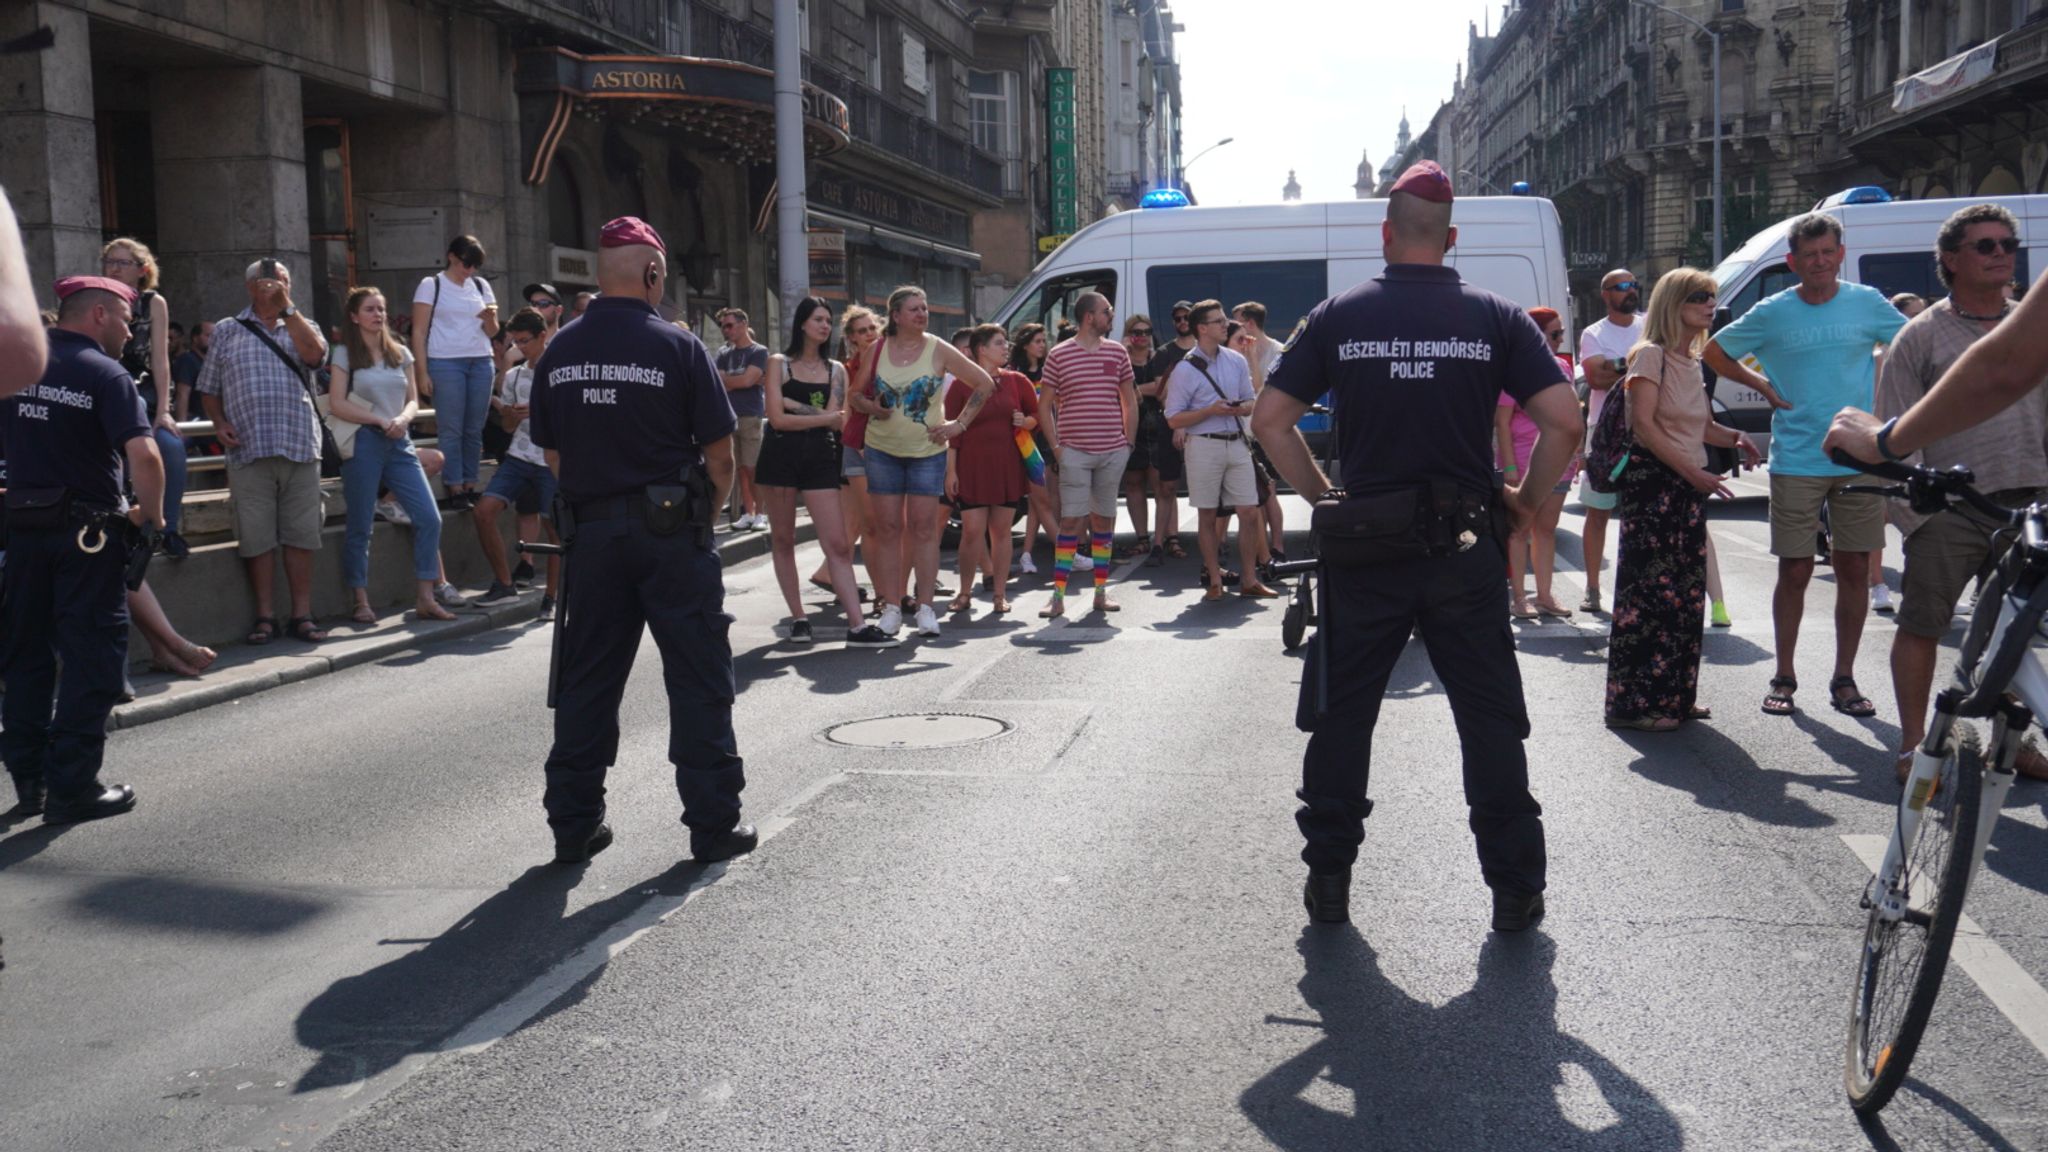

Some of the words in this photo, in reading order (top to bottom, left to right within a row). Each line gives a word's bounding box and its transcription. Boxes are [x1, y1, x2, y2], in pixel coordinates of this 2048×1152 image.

[591, 71, 686, 90] ASTORIA
[1054, 71, 1067, 141] ASTOR
[854, 185, 899, 220] ASTORIA
[559, 257, 589, 276] HOTEL
[1338, 337, 1410, 361] KÉSZENLÉTI
[1413, 336, 1491, 361] RENDŐRSÉG
[1782, 326, 1823, 349] HEAVY
[601, 362, 664, 387] RENDŐRSÉG
[1390, 361, 1435, 379] POLICE
[38, 385, 93, 410] RENDŐRSÉG
[583, 389, 616, 404] POLICE
[18, 403, 49, 421] POLICE
